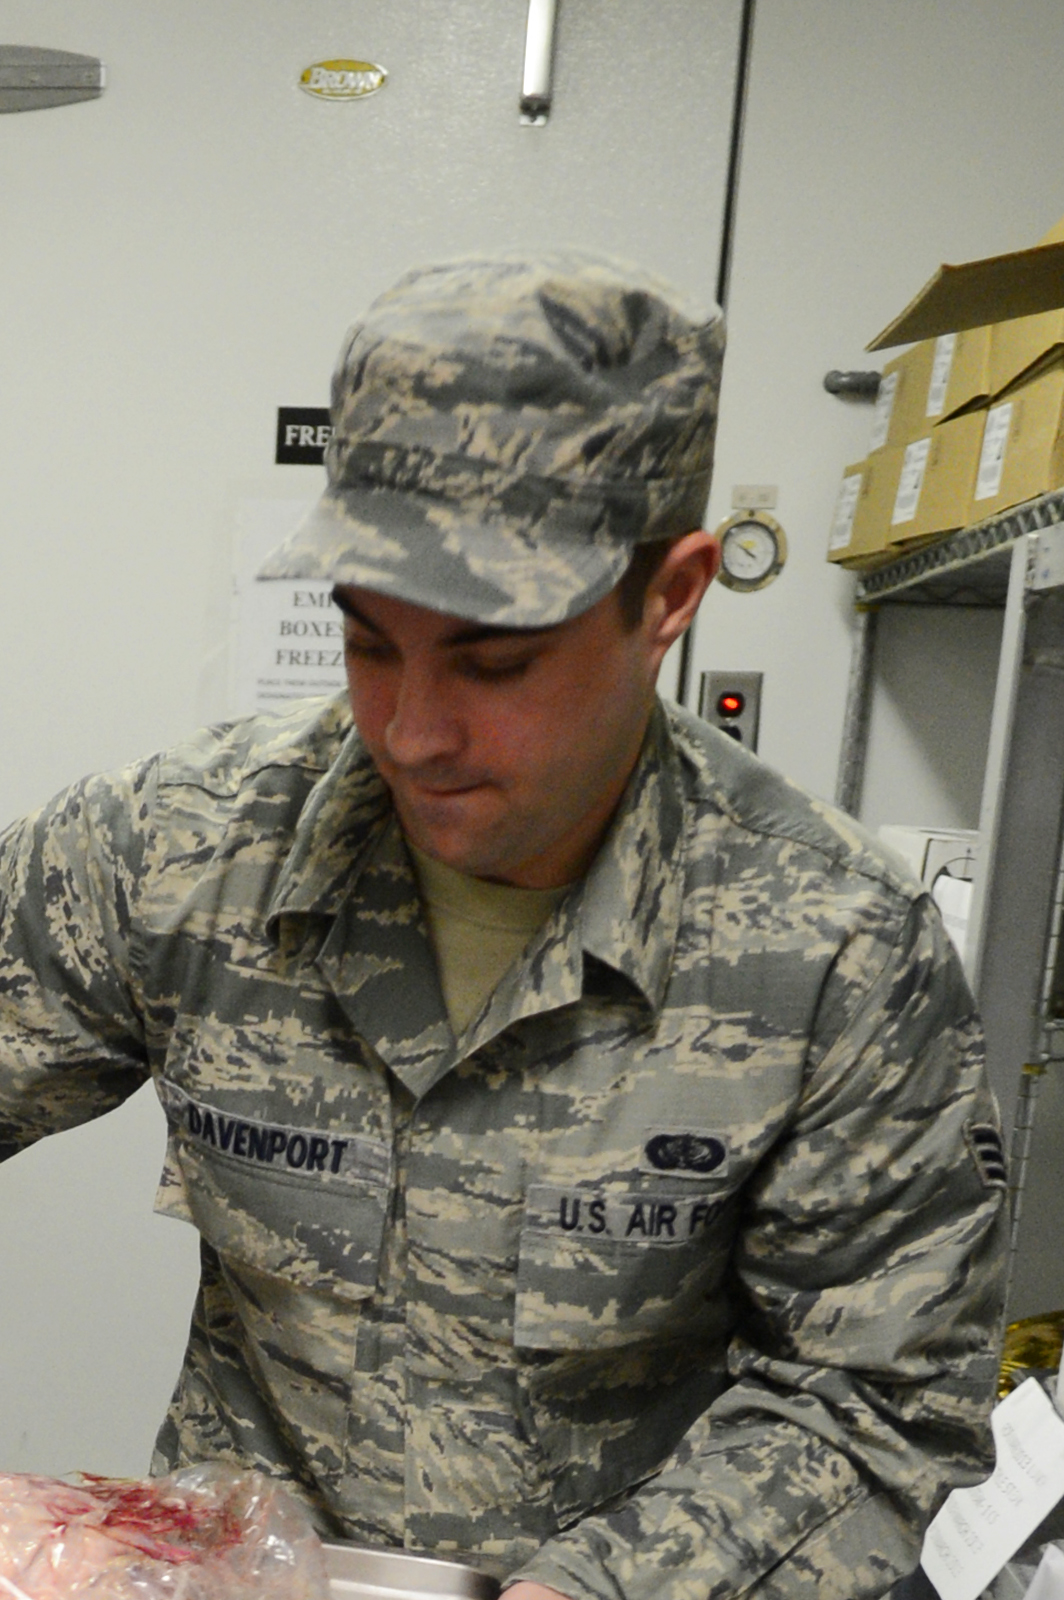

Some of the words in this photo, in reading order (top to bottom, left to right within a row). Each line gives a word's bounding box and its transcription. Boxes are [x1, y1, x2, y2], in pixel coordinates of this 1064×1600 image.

[308, 67, 383, 89] BROWN
[285, 424, 334, 447] FRE
[187, 1102, 349, 1175] DAVENPORT
[559, 1195, 613, 1236] U.S.
[624, 1203, 678, 1238] AIR
